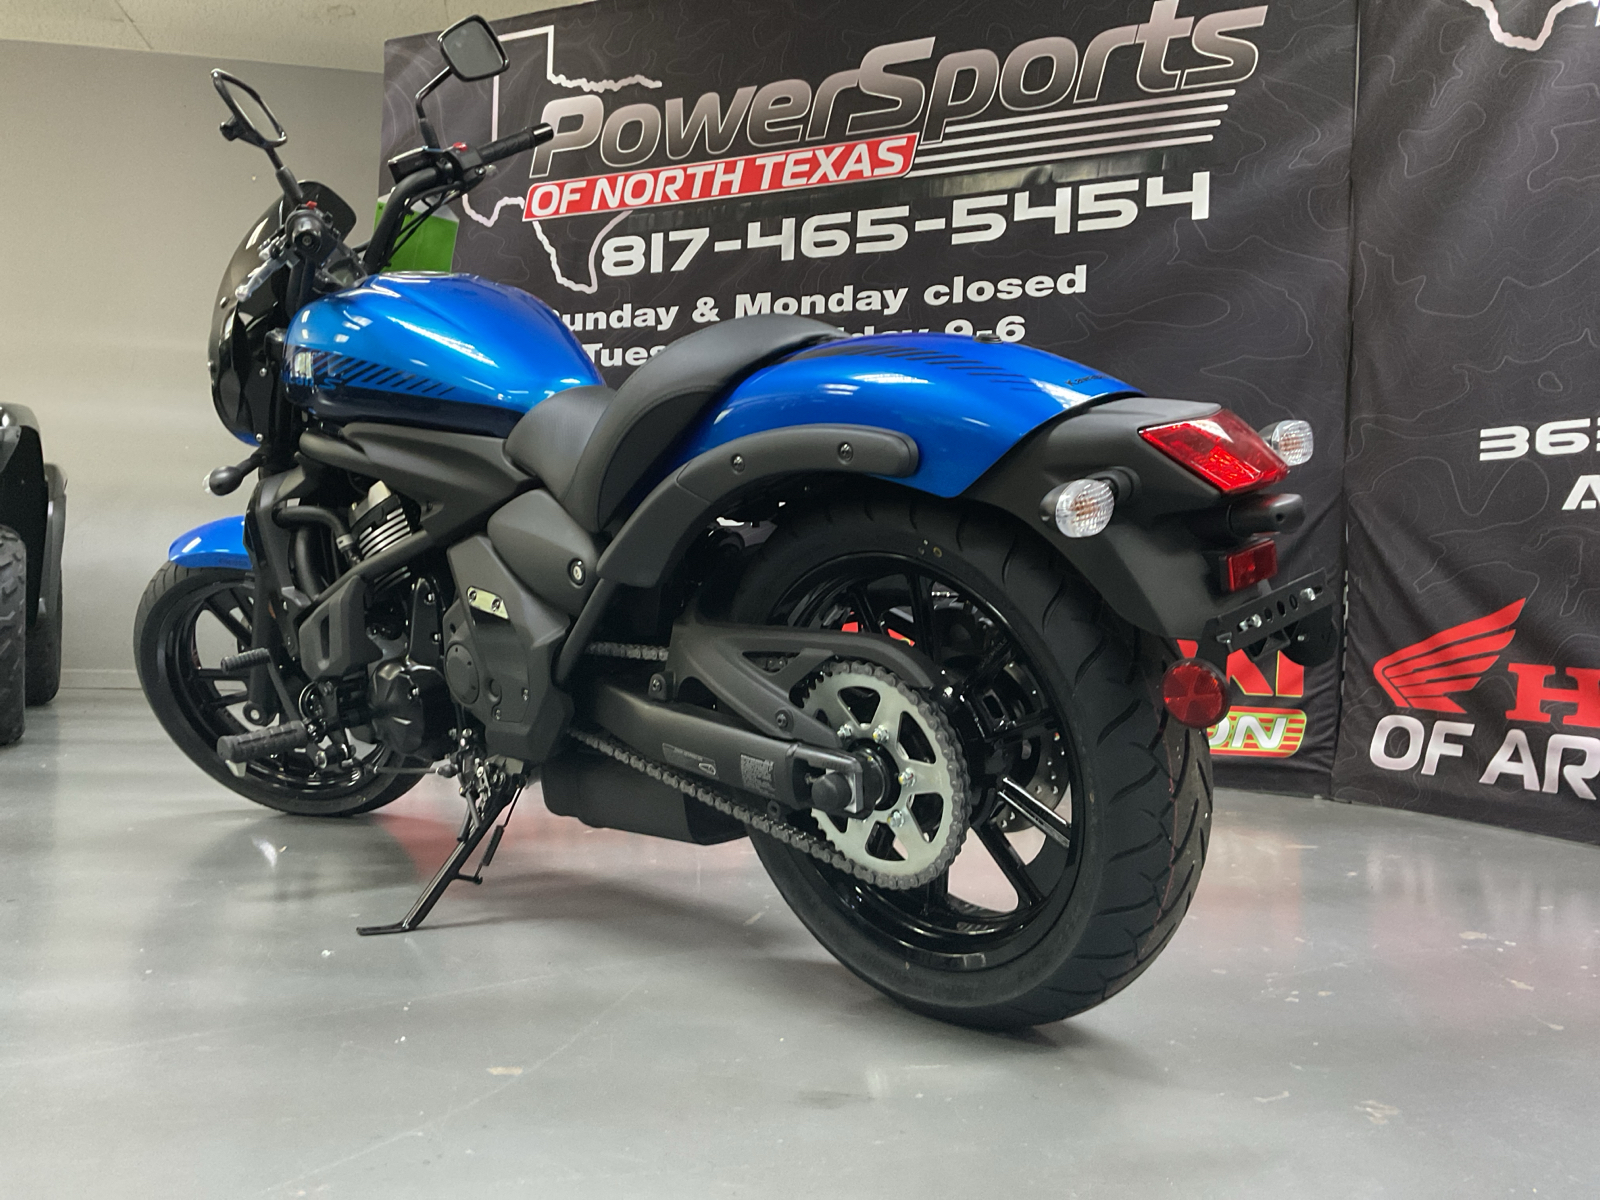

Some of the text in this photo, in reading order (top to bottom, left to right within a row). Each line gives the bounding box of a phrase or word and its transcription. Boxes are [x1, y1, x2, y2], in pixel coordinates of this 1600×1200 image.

[529, 0, 1269, 178] PowerSports
[531, 137, 909, 216] OF NORTH TEXAS
[600, 171, 1211, 277] 817-465-5454
[552, 264, 1088, 331] unday & Monday closed
[1479, 418, 1600, 461] 36
[1369, 714, 1475, 776] OF
